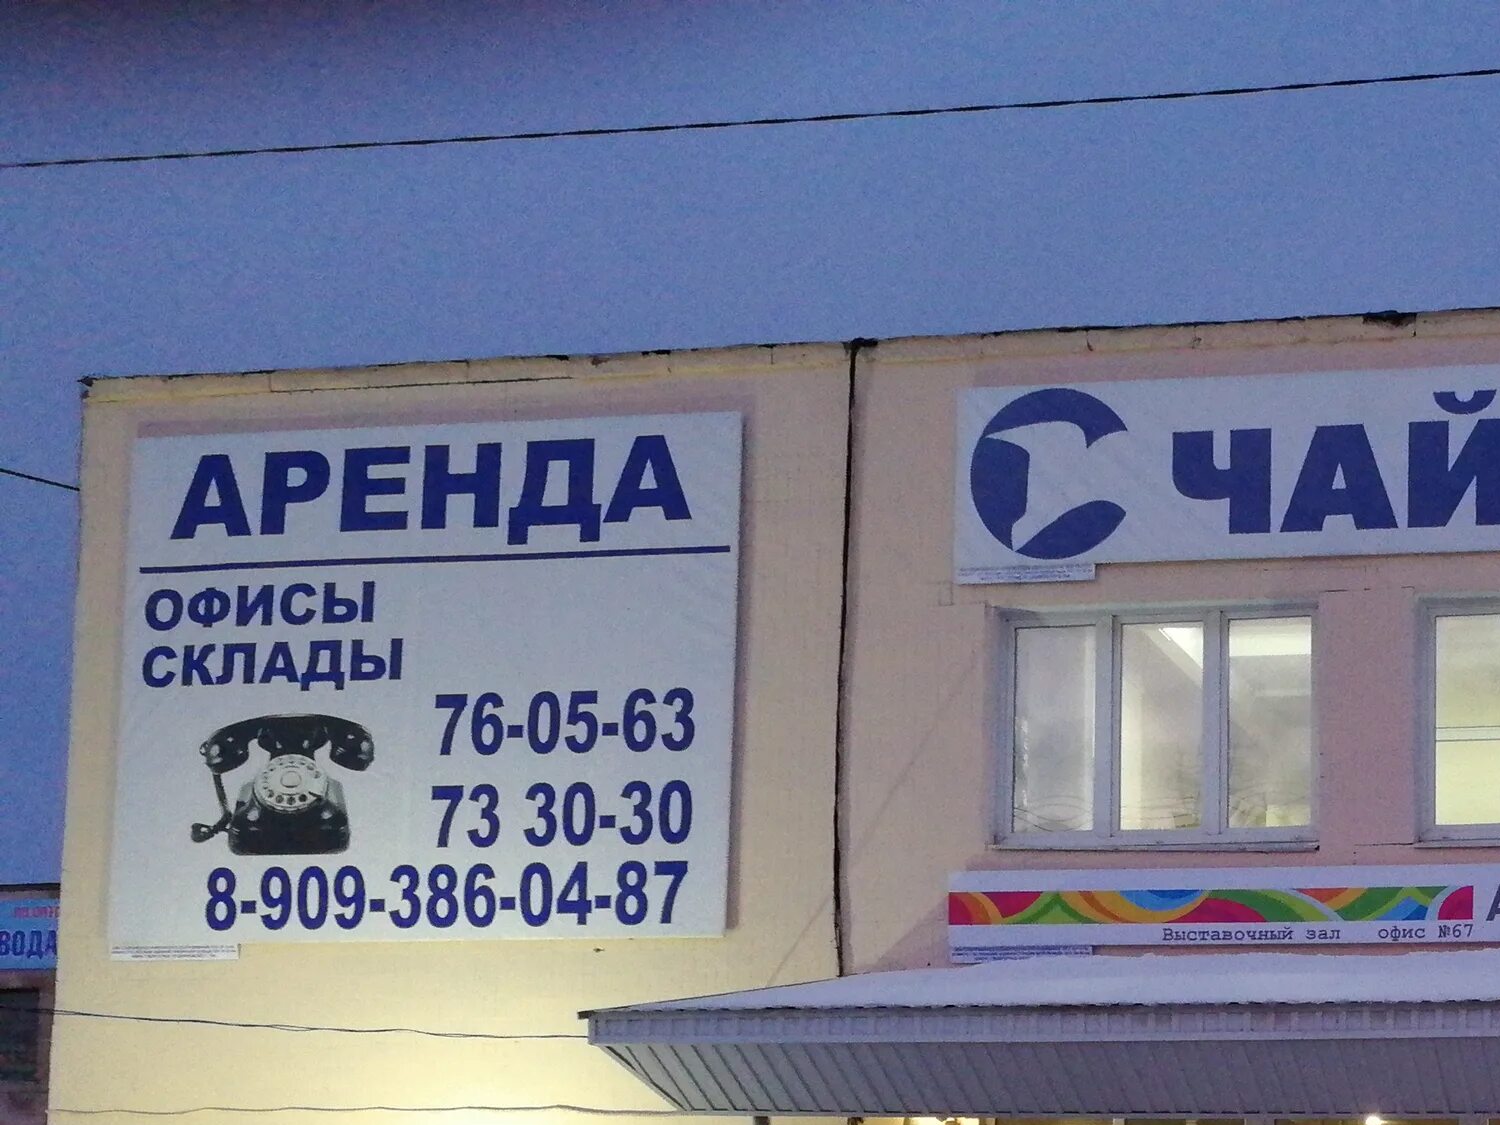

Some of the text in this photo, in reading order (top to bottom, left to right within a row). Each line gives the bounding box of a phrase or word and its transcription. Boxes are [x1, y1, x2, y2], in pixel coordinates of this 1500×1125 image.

[170, 434, 692, 546] АРЕНДА
[144, 580, 376, 631] ОФИСЫ
[142, 638, 404, 692] СКЛАДЫ
[434, 688, 696, 756] 76-05-63
[431, 780, 693, 848] 73 30-30
[205, 860, 690, 931] 8-909-386-04-87
[1162, 923, 1474, 941] Выставочный зал офис №67
